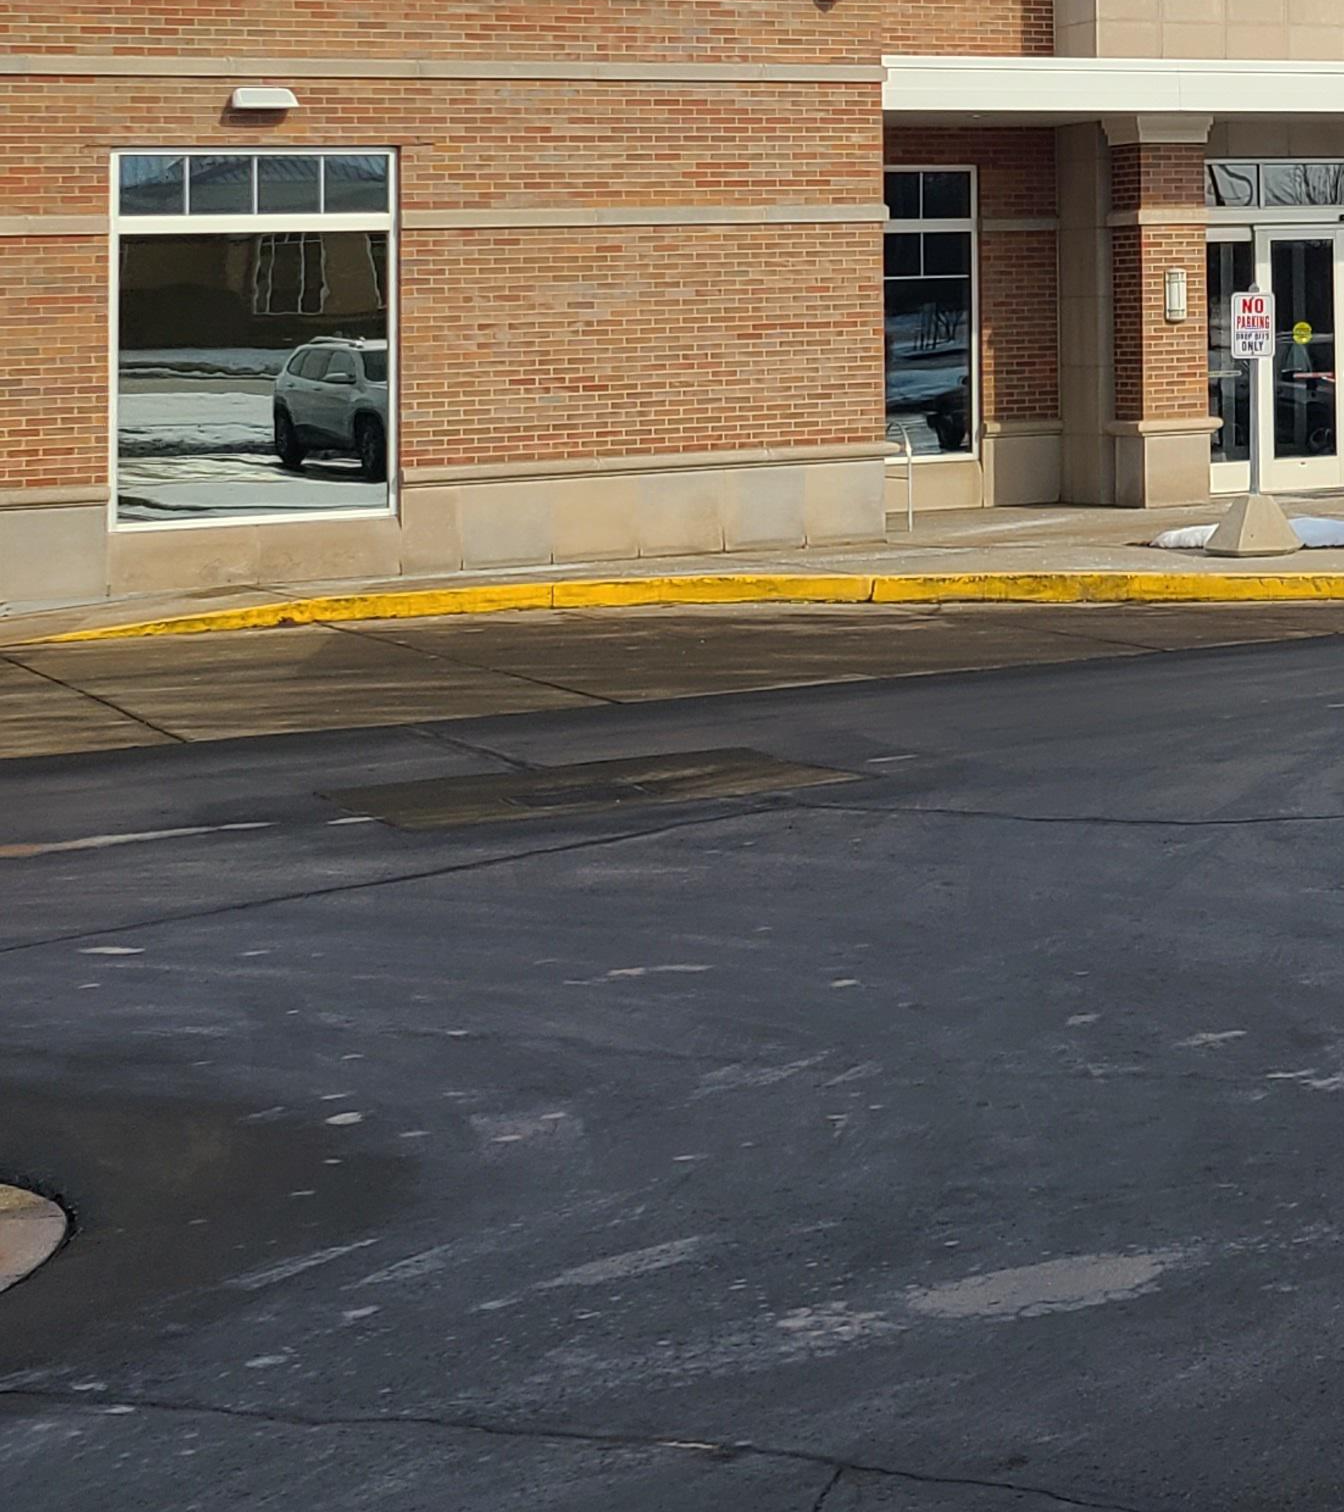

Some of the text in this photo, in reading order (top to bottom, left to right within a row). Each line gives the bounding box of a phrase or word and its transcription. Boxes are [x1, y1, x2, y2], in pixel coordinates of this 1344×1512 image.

[1242, 298, 1264, 313] NO
[1236, 315, 1270, 329] PARKING
[1241, 341, 1264, 351] ONLY
